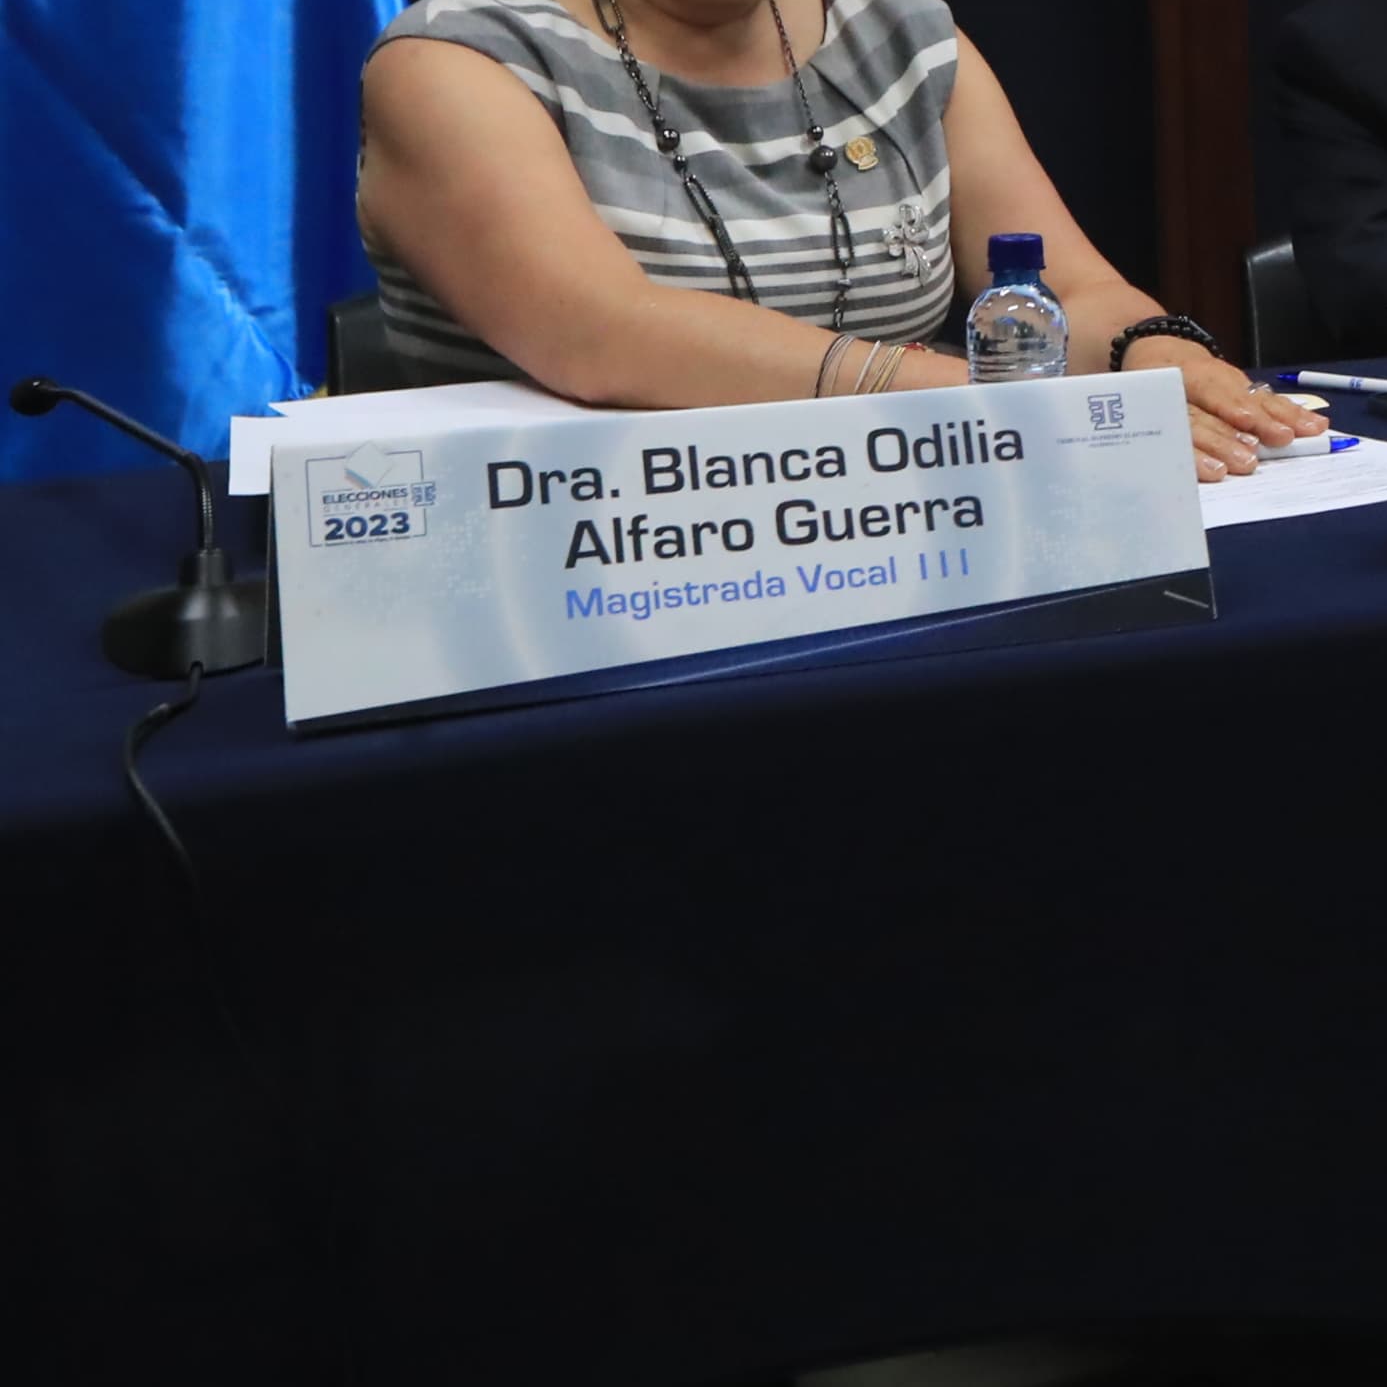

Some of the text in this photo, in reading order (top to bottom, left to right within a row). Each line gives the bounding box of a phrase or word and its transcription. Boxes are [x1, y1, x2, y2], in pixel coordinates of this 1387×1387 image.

[322, 487, 409, 505] ELECCIONES
[487, 419, 1024, 510] Dra. Blanca Odilia
[324, 512, 410, 541] 2023
[565, 494, 984, 569] Alfaro Guerra
[566, 570, 785, 620] Magistrada
[796, 556, 898, 594] Vocal
